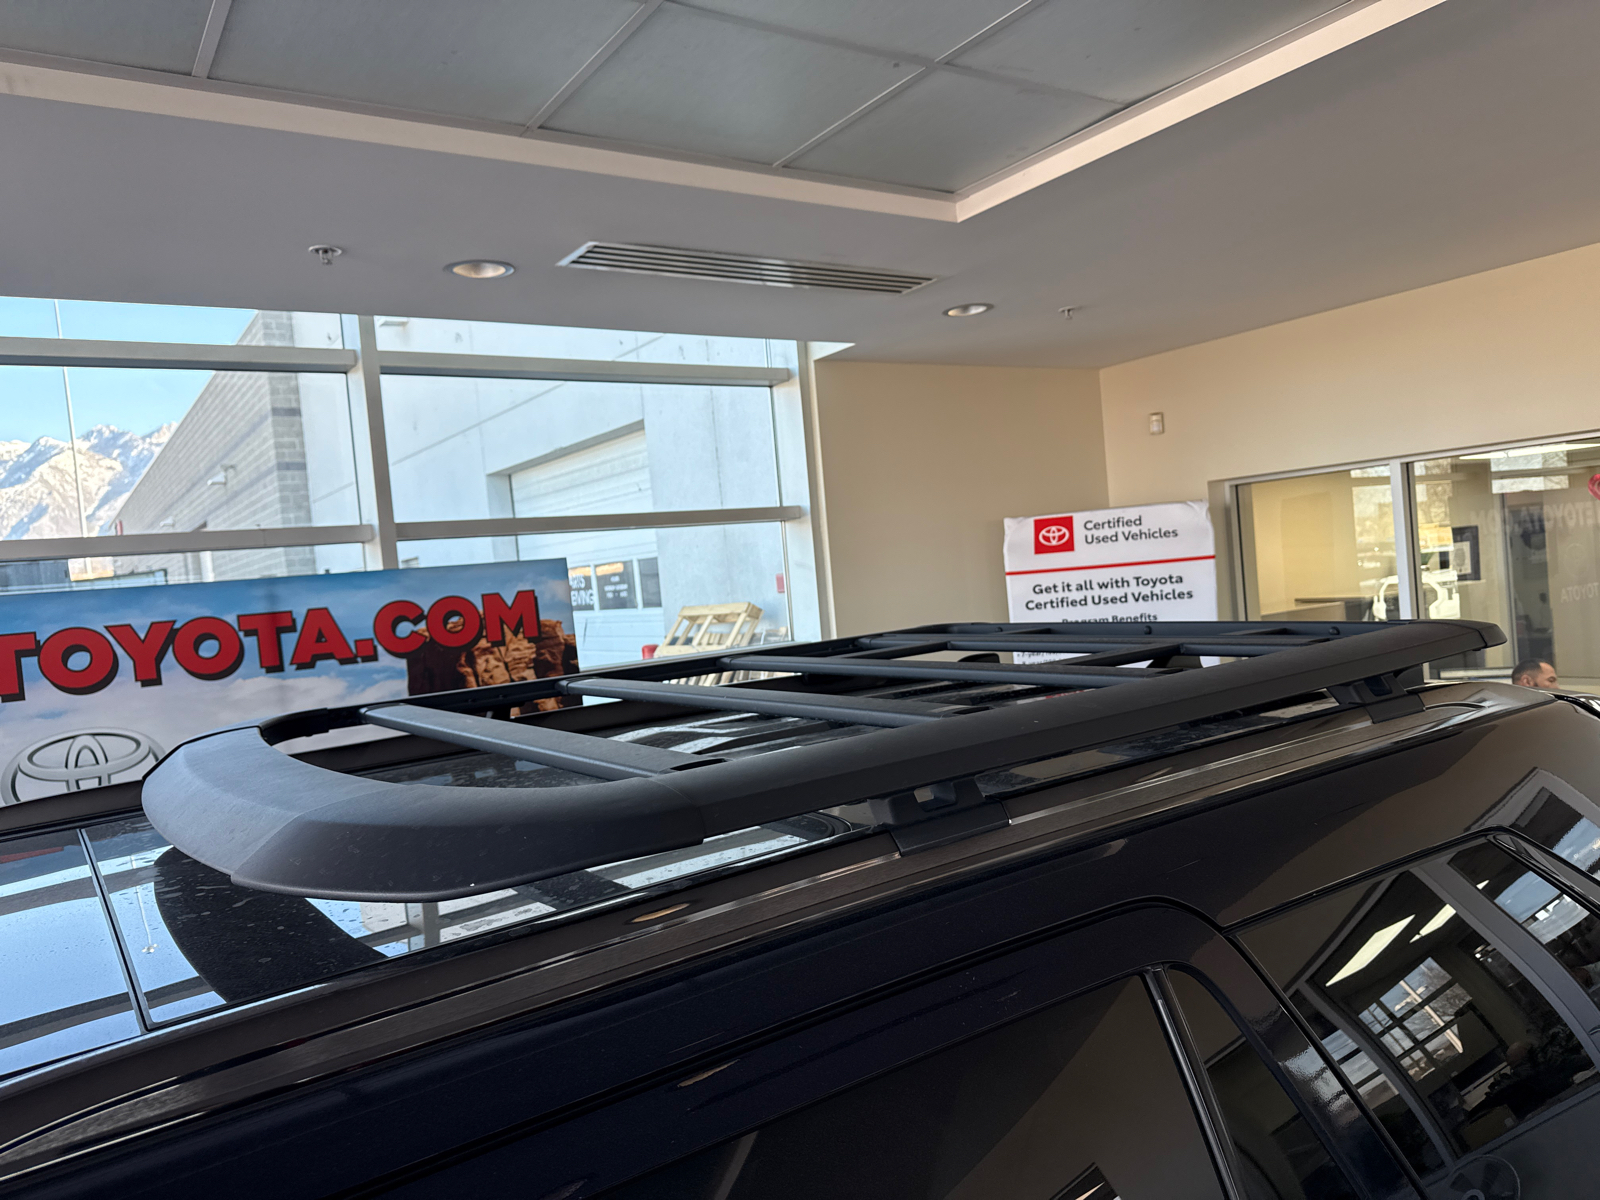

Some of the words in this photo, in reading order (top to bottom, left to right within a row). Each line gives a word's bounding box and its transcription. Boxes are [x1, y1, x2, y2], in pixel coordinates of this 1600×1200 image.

[1083, 515, 1142, 531] Certified
[1084, 530, 1119, 545] Used
[1121, 527, 1178, 542] Vehicles
[1032, 584, 1058, 595] Get
[1062, 582, 1073, 593] it
[1075, 579, 1094, 592] all
[1096, 576, 1130, 589] with
[1132, 574, 1184, 591] Toyota
[1025, 594, 1088, 610] Certified
[1091, 591, 1128, 605] Used
[1131, 588, 1193, 603] Vehicles
[1111, 613, 1158, 623] Benefits
